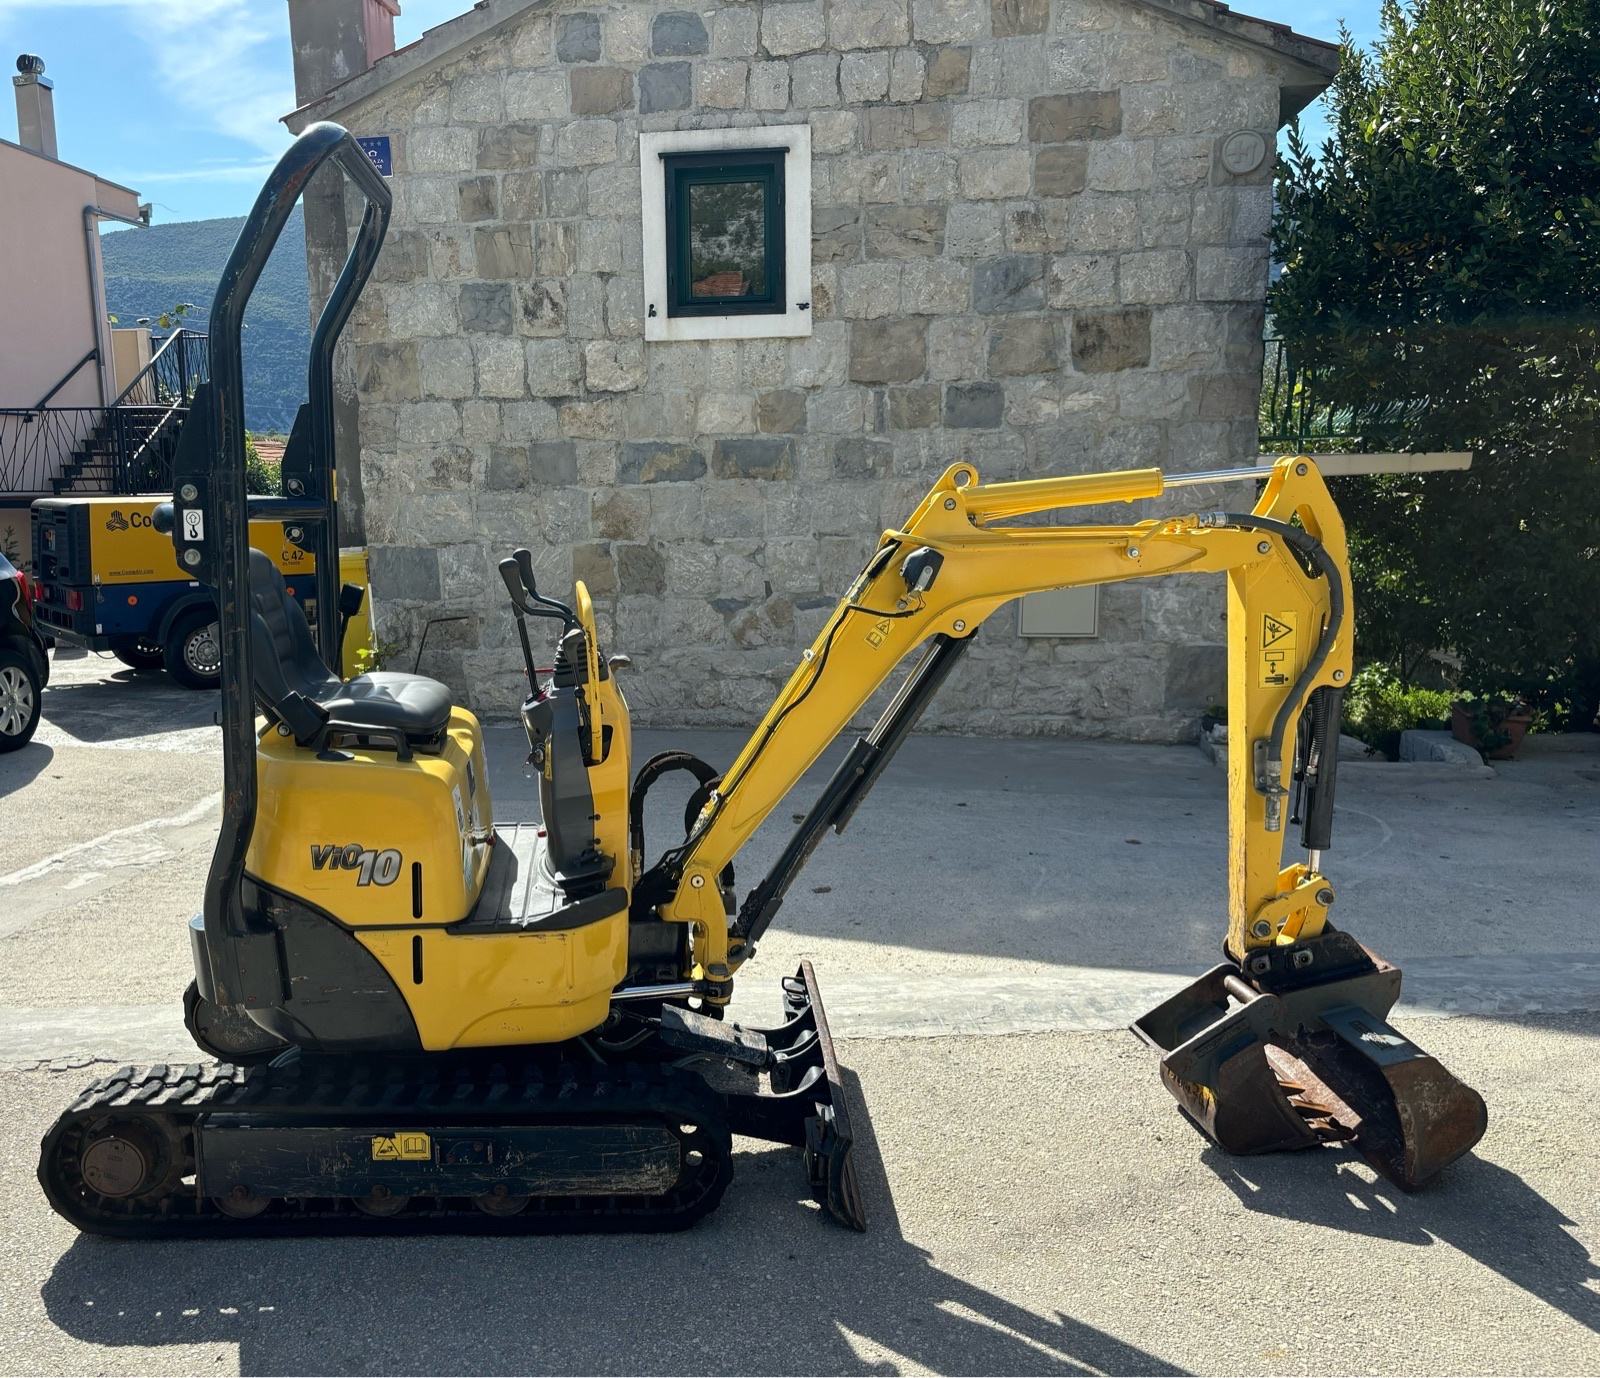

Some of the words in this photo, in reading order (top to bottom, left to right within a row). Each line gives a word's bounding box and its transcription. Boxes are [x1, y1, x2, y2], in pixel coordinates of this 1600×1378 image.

[130, 511, 152, 528] Co
[282, 551, 290, 561] C
[291, 550, 304, 561] 42
